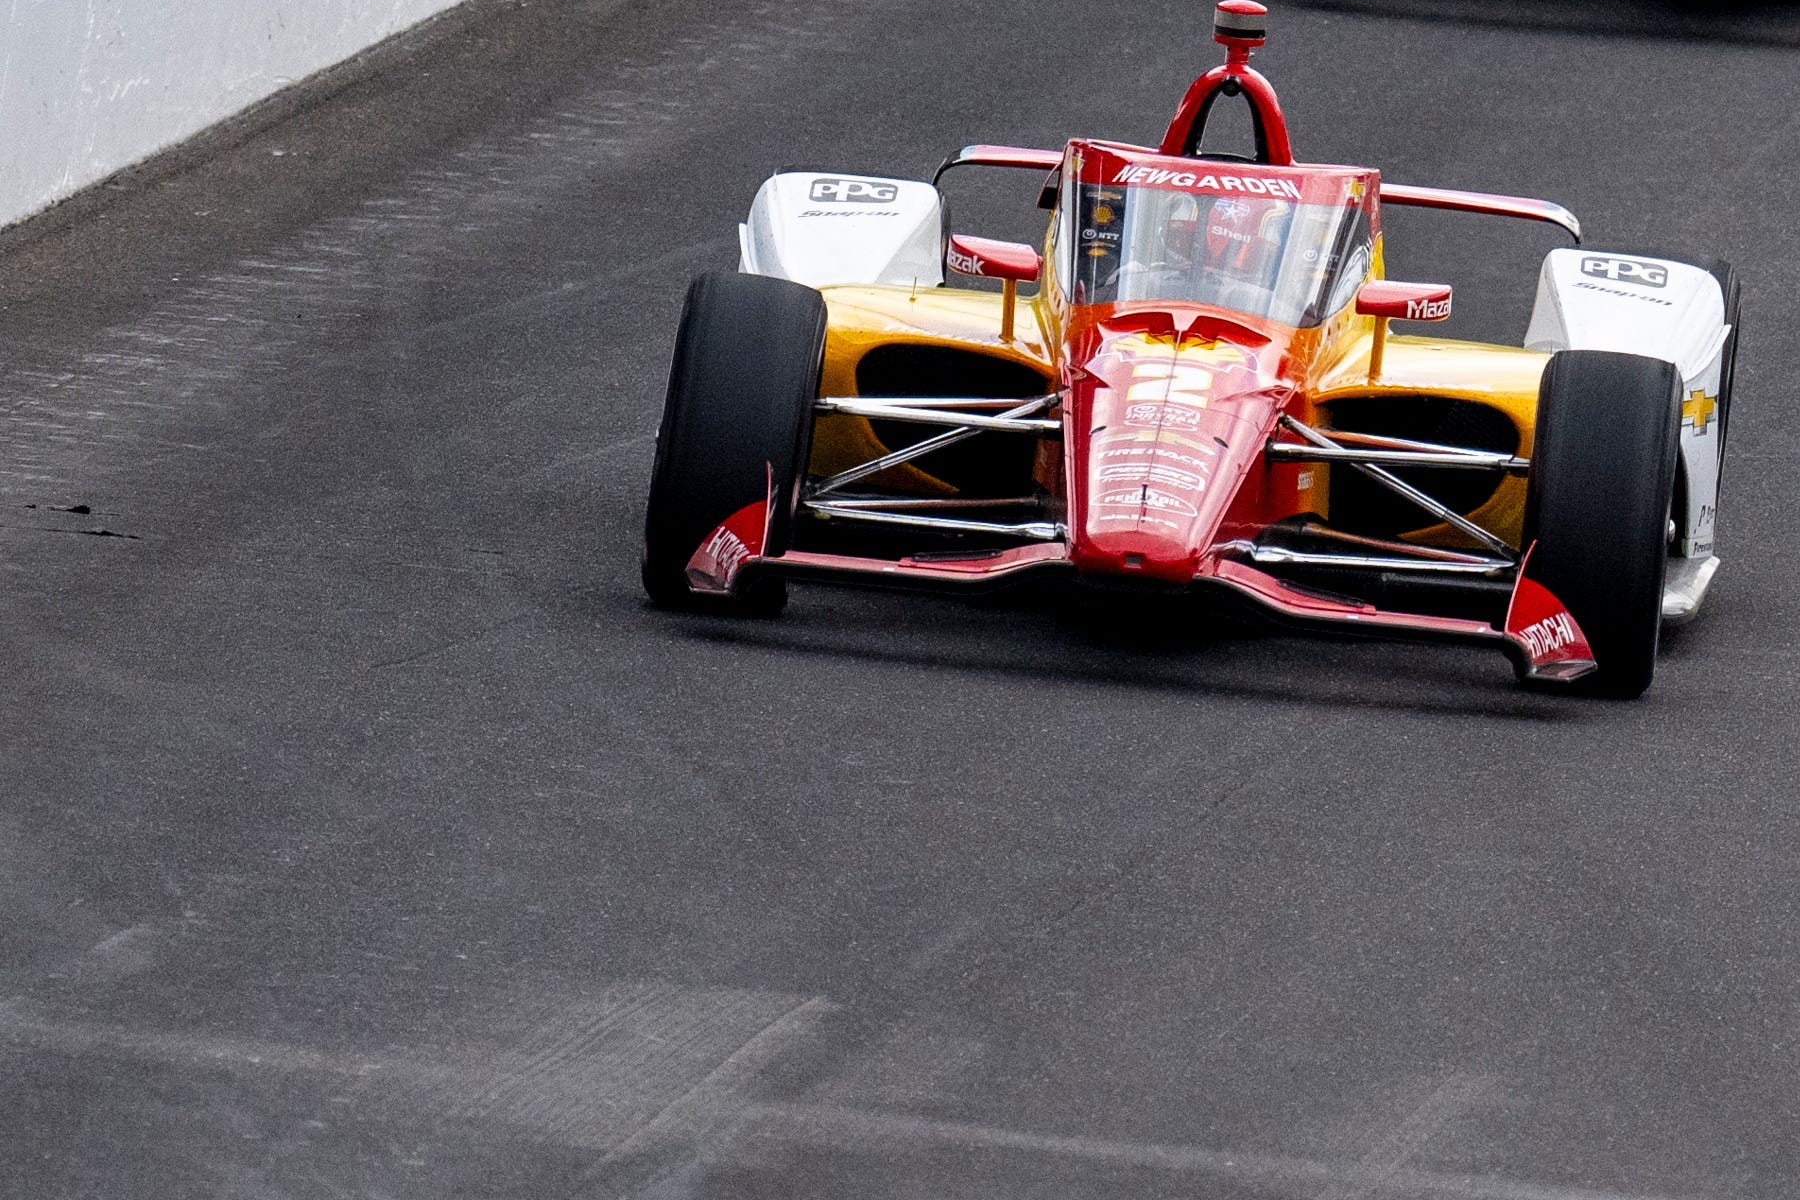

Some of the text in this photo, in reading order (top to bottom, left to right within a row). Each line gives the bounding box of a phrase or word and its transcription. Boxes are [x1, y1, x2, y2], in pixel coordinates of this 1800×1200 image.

[811, 180, 897, 202] PPG
[1112, 164, 1304, 200] NEWGARDEN
[1098, 231, 1120, 241] NTT
[1211, 224, 1252, 244] Shell
[1582, 258, 1668, 288] PPG
[1126, 363, 1214, 409] 2
[1519, 612, 1575, 659] HITACHI
